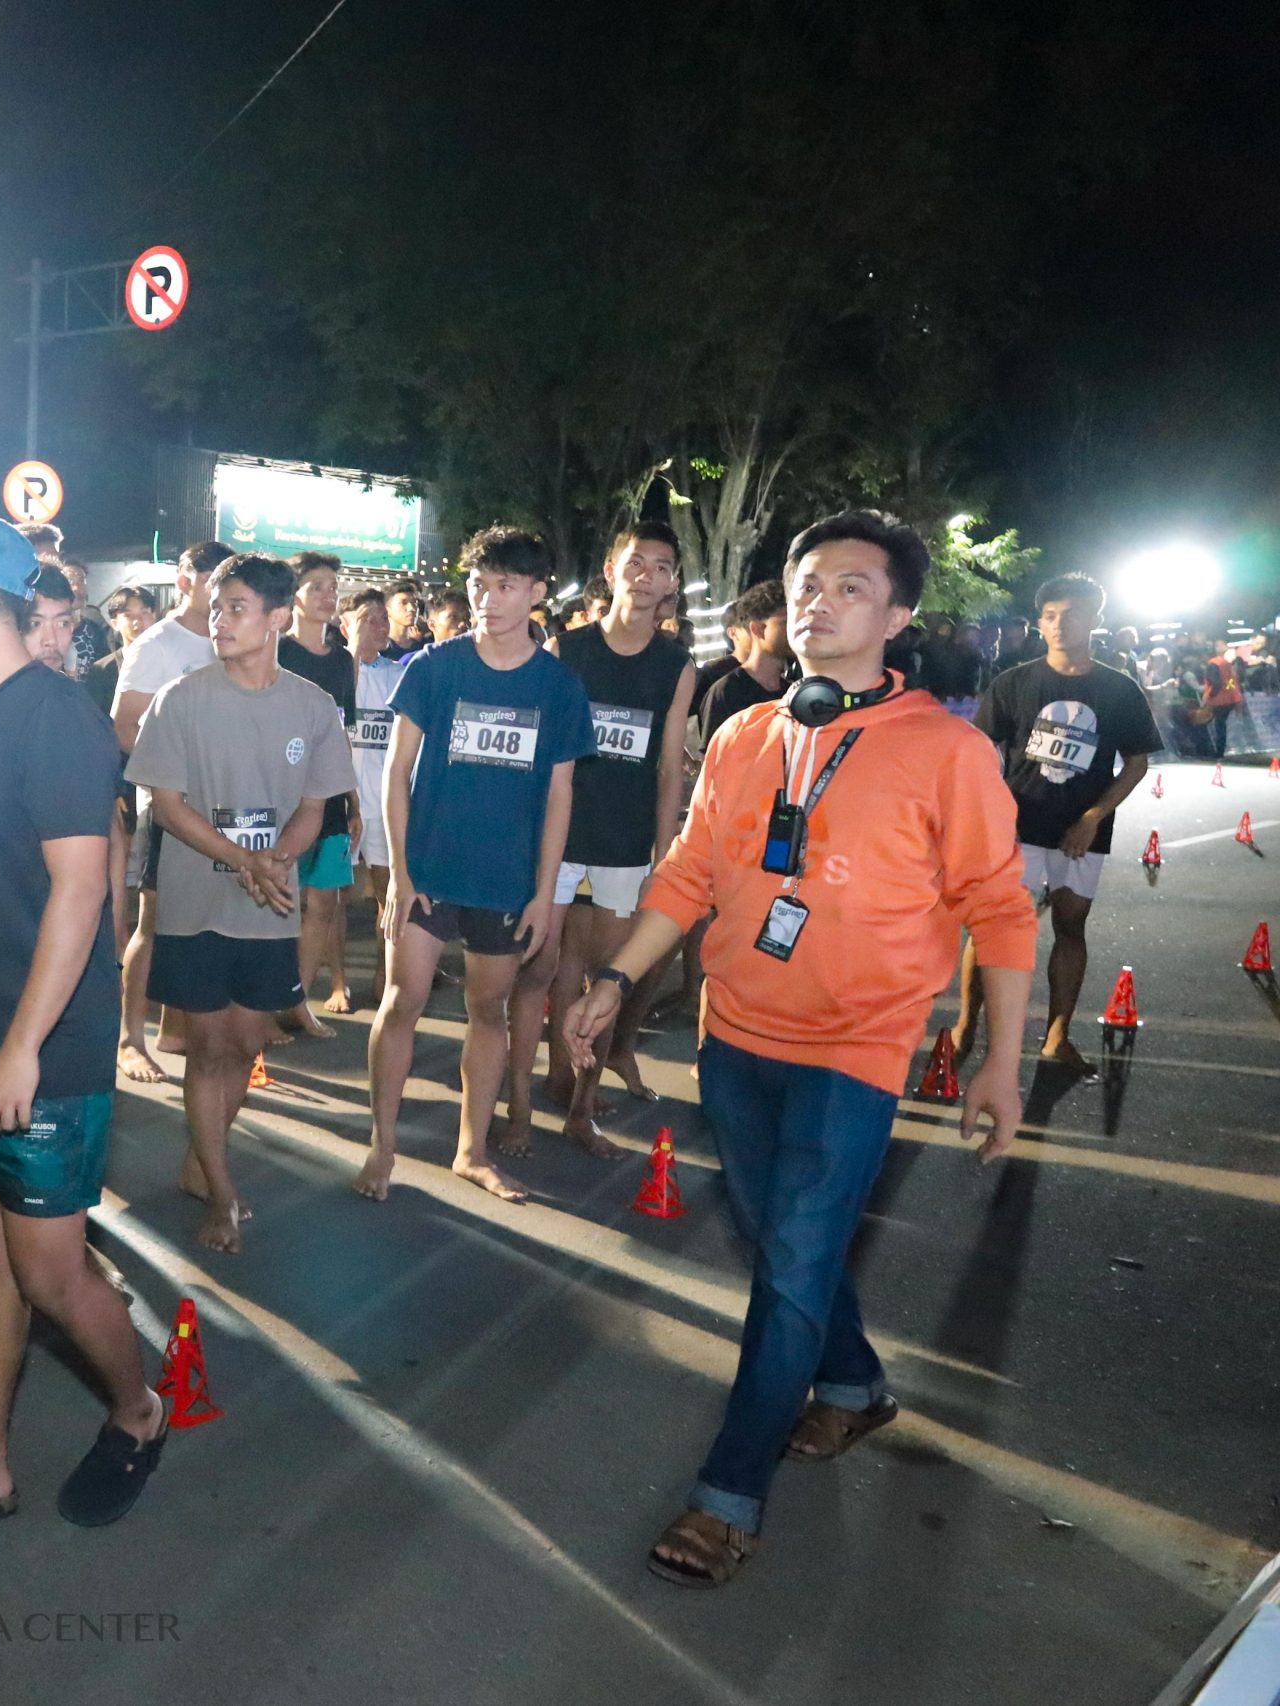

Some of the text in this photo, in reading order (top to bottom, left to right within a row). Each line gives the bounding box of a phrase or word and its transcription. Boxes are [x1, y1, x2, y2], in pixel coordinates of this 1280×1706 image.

[362, 724, 387, 740] 003
[477, 728, 521, 754] 048
[595, 725, 635, 750] 046
[1049, 739, 1081, 760] 017
